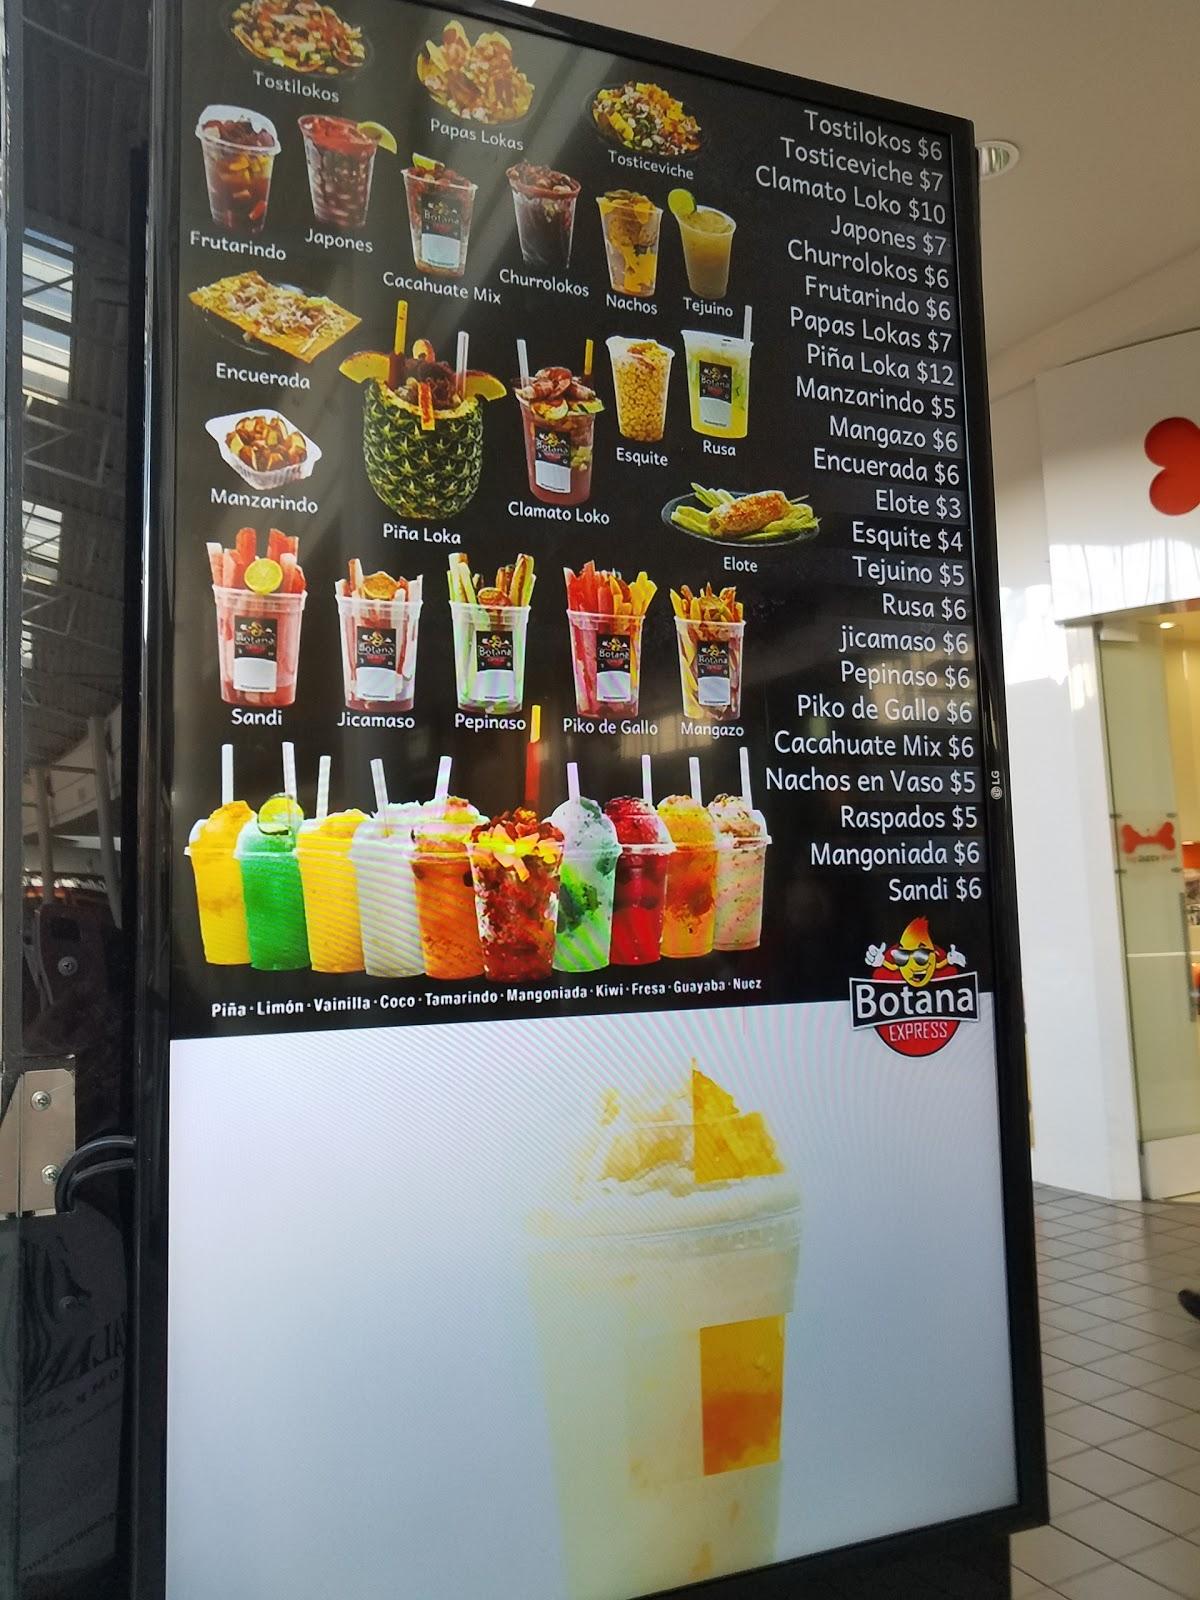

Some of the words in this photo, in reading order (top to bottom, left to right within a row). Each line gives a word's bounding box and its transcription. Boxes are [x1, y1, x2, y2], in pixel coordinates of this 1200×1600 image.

[252, 69, 340, 103] Tostilokos
[430, 117, 477, 141] Papas
[481, 129, 524, 151] Lokas
[803, 108, 912, 155] Tostilokos
[917, 136, 943, 161] $6
[607, 149, 694, 181] Tosticeviche
[779, 136, 914, 187] Tosticeviche
[919, 167, 944, 193] $7
[754, 164, 848, 204] Clamato
[853, 185, 902, 215] Loko
[908, 197, 946, 225] $10
[190, 230, 287, 261] Frutarindo
[304, 228, 374, 254] Japones
[830, 214, 917, 251] Japones
[922, 231, 947, 256] $7
[787, 238, 919, 284] Churrolokos
[924, 264, 950, 289] $6
[382, 271, 469, 299] Cacahuate
[473, 284, 502, 306] Mix
[499, 268, 590, 297] Churrolokos
[805, 275, 920, 316] Frutarindo
[926, 296, 951, 321] $6
[606, 293, 658, 316] Nachos
[682, 296, 734, 318] Tejuino
[790, 305, 856, 338] Papas
[862, 318, 922, 349] Lokas
[927, 328, 952, 353] $7
[216, 362, 311, 390] Encuerada
[807, 342, 855, 371] Piña
[860, 351, 910, 379] Loka
[916, 359, 955, 387] $12
[795, 375, 925, 415] Manzarindo
[931, 394, 956, 420] $5
[702, 439, 737, 457] Rusa
[829, 415, 926, 449] Mangazo
[932, 427, 958, 453] $6
[616, 446, 669, 467] Esquite
[813, 447, 928, 482] Encuerada
[934, 461, 960, 486] $6
[210, 487, 319, 514] Manzarindo
[507, 500, 572, 522] Clamato
[575, 507, 610, 525] Loko
[875, 488, 930, 516] Elote
[935, 494, 962, 520] $3
[383, 522, 419, 541] Piña
[423, 527, 462, 545] Loka
[852, 520, 932, 552] Esquite
[937, 528, 964, 554] $4
[723, 556, 758, 573] Elote
[851, 555, 933, 586] Tejuino
[939, 561, 965, 588] $5
[882, 592, 935, 618] Rusa
[941, 596, 967, 622] $6
[838, 624, 936, 653] jicamaso
[942, 630, 969, 656] $6
[841, 660, 938, 690] Pepinaso
[944, 665, 971, 690] $6
[231, 707, 283, 726] Sandi
[336, 711, 416, 729] Jicamaso
[454, 712, 527, 733] Pepinaso
[797, 693, 845, 719] Piko
[851, 695, 879, 720] de
[884, 697, 940, 722] Gallo
[946, 698, 973, 725] $6
[563, 717, 595, 734] Piko
[598, 718, 617, 734] de
[620, 719, 659, 736] Gallo
[680, 720, 745, 740] Mangazo
[774, 729, 897, 757] Cacahuate
[903, 734, 942, 757] Mix
[948, 734, 974, 761] $6
[765, 766, 851, 792] Nachos
[857, 774, 884, 792] en
[889, 769, 944, 793] Vaso
[950, 769, 976, 796] $5
[840, 804, 946, 835] Raspados
[951, 804, 978, 831] $5
[811, 839, 948, 872] Mangoniada
[953, 839, 980, 867] $6
[888, 876, 949, 902] Sandi
[955, 875, 982, 902] $6
[211, 1002, 247, 1018] Piña
[256, 999, 304, 1016] Limón
[313, 996, 371, 1012] Vainilla
[379, 994, 416, 1009] Coco
[424, 990, 498, 1007] Tamarindo
[506, 985, 588, 1004] Mangoniada
[595, 983, 624, 997] Kiwi
[631, 982, 666, 996] Fresa
[673, 979, 726, 995] Guayaba
[732, 977, 762, 990] Nuez
[855, 983, 975, 1019] Botana
[888, 1021, 949, 1042] EXPRESS
